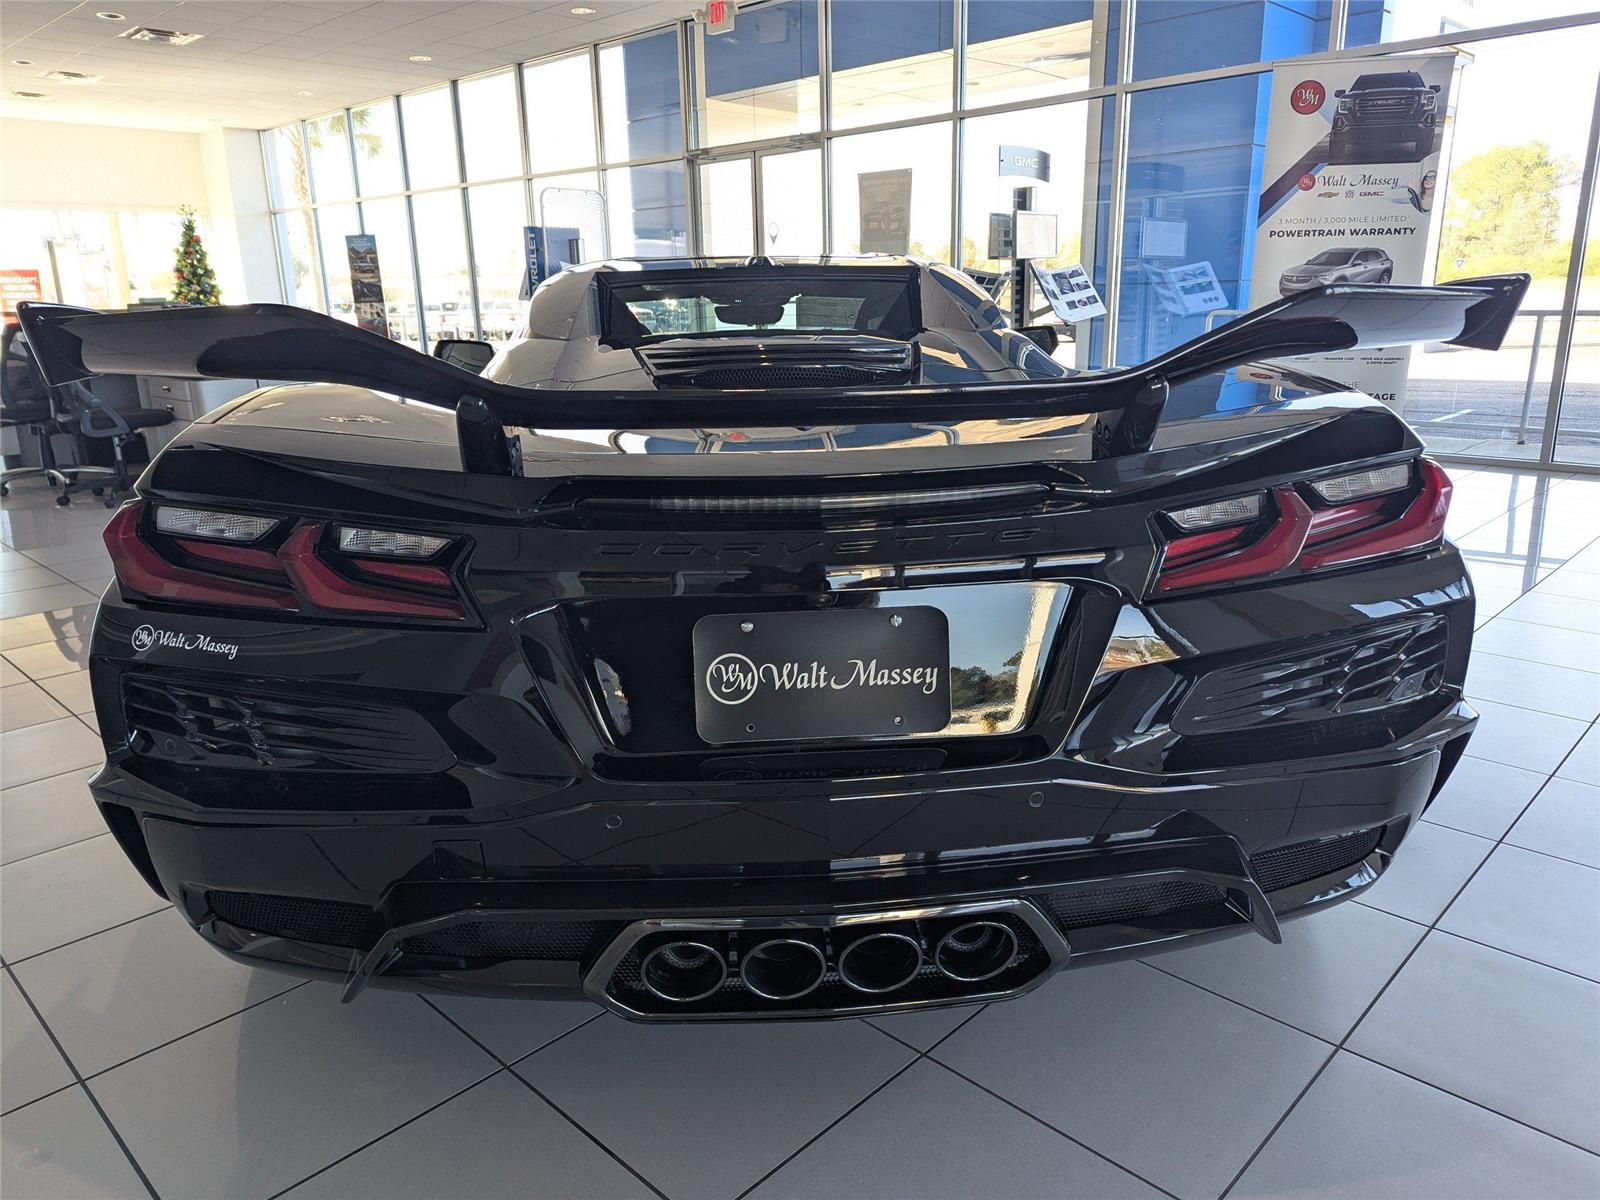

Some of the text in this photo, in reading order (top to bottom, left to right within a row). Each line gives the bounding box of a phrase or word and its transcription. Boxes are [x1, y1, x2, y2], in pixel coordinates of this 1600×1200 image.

[1014, 155, 1039, 169] GMC
[1318, 174, 1347, 187] Walt
[1350, 173, 1399, 189] Massey
[1269, 227, 1416, 238] POWERTRAIN WARRANTY
[599, 527, 1041, 564] CORVETTE
[155, 630, 185, 648] Walt
[185, 635, 239, 660] Massey
[760, 661, 827, 690] Walt
[830, 659, 938, 694] Massey
